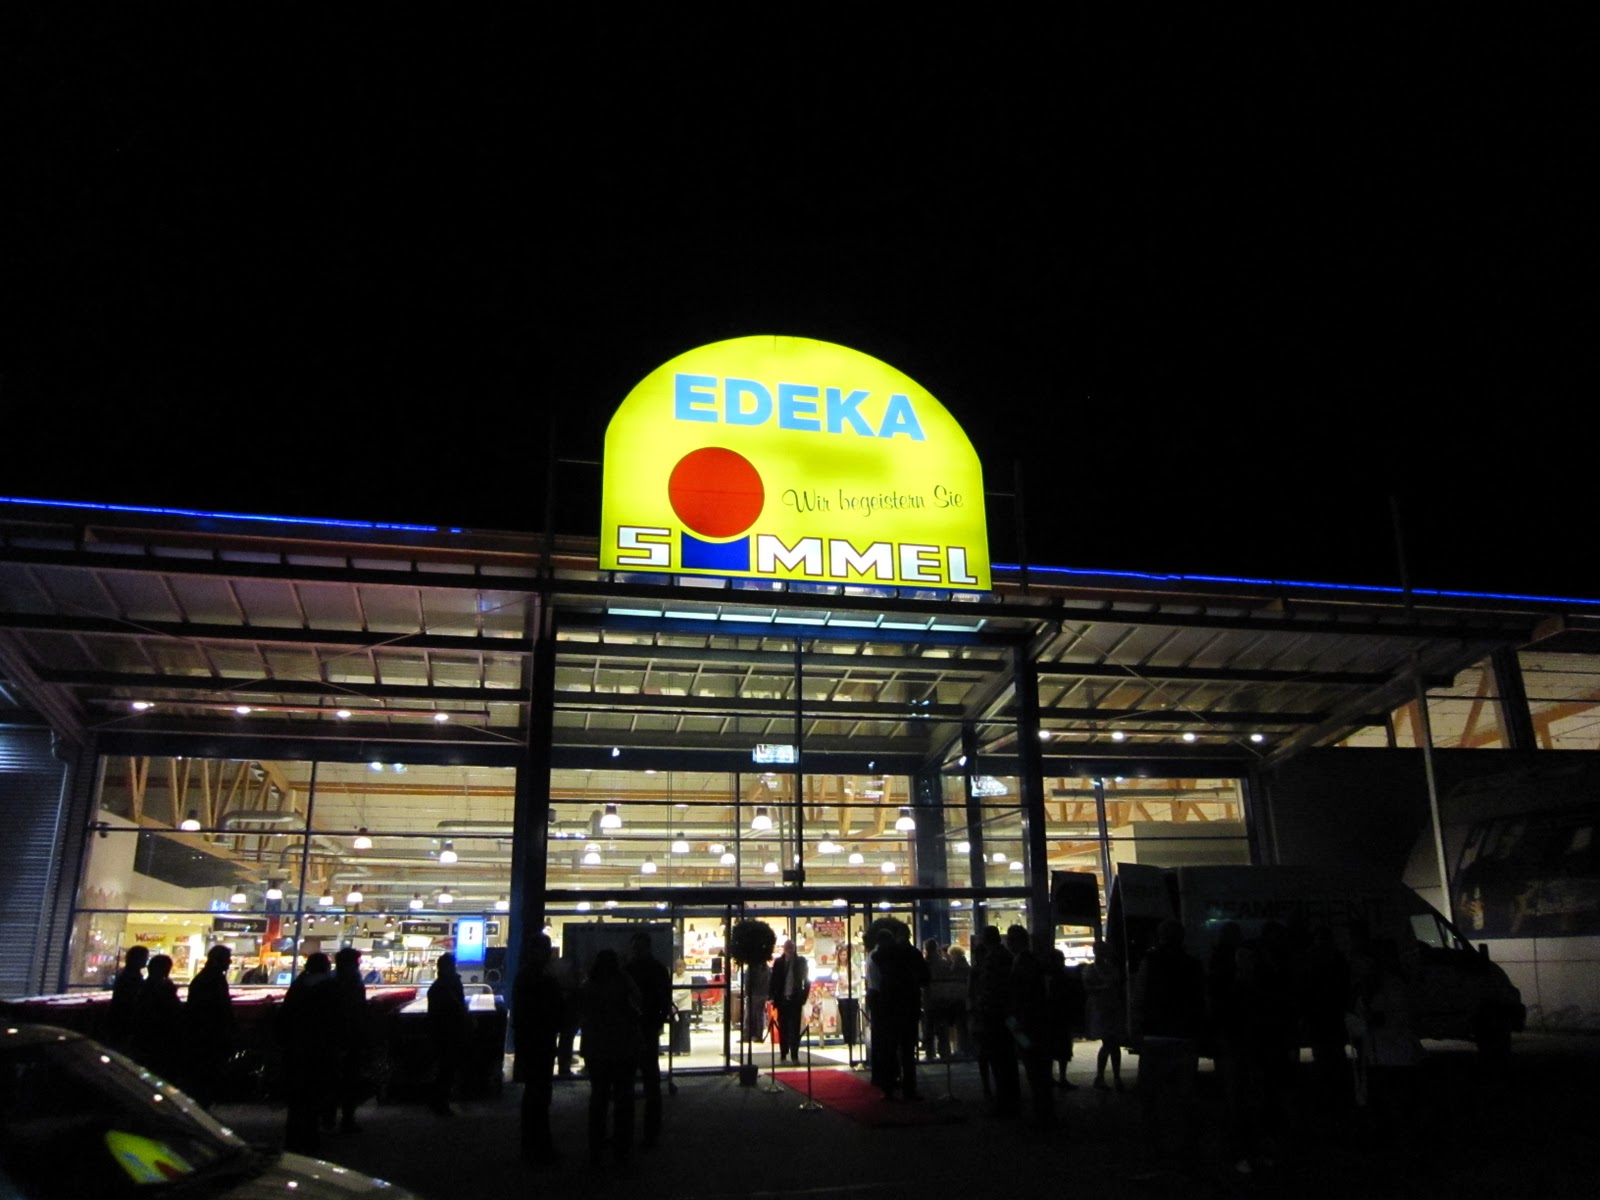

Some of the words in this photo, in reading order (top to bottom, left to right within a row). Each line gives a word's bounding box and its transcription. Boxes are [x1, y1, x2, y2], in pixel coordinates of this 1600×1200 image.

[674, 373, 926, 441] EDEKA
[781, 488, 831, 513] Wir
[839, 488, 925, 517] begeistern
[933, 485, 964, 509] Sie
